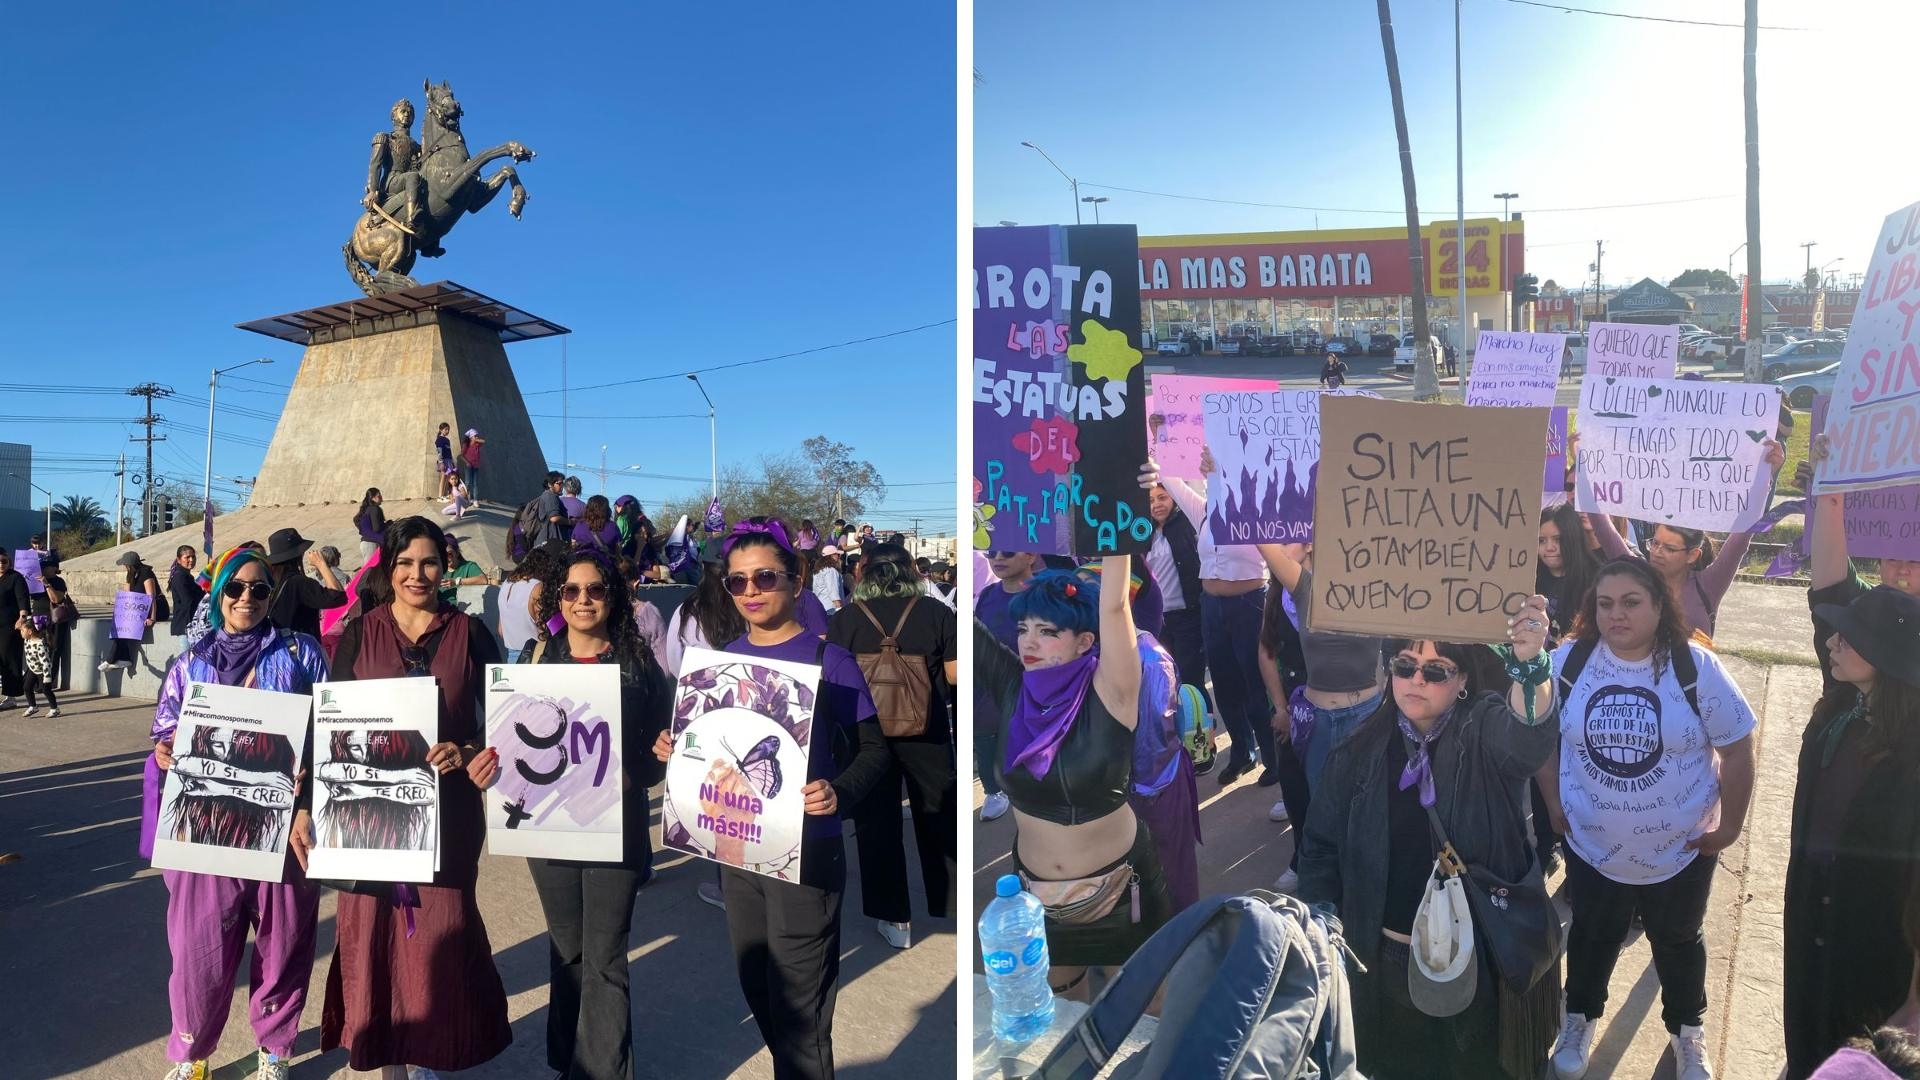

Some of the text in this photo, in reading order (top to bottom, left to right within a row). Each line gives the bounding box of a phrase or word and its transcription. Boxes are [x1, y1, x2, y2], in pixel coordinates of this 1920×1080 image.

[1138, 252, 1372, 290] LA MAS BARATA
[1439, 240, 1490, 274] 24
[973, 264, 1112, 318] ROTA
[1007, 322, 1072, 359] LAS
[1480, 333, 1524, 351] Marcho
[1594, 328, 1672, 360] QUIERO QUE
[973, 357, 1127, 421] ESTATUAS
[1205, 393, 1263, 414] SOMOS
[1272, 392, 1292, 414] EL
[1589, 382, 1767, 417] LUCHA AUNQUE LO
[1228, 416, 1260, 436] LAS
[1264, 416, 1292, 436] QUE
[1607, 426, 1739, 458] TENGAS TODO
[1822, 405, 1920, 475] MIED
[1030, 427, 1075, 461] DEL
[1347, 432, 1473, 484] SI ME
[1577, 449, 1606, 475] POR
[1613, 453, 1671, 480] TODAS
[1682, 461, 1711, 483] LAS
[1720, 463, 1753, 484] QUE
[987, 460, 1153, 552] PATRIARCADO
[1342, 485, 1527, 531] FALTA UNA
[1593, 480, 1750, 513] NO LO TIENEN
[1230, 522, 1250, 541] NO
[1257, 520, 1286, 540] NOS
[1338, 536, 1528, 573] YO TAMBIÉN LO
[1326, 577, 1531, 617] QUEMO TODO
[1589, 719, 1657, 736] GRITO DE LAS
[1600, 706, 1647, 719] SOMOS EL
[1590, 733, 1607, 746] QUE
[1610, 733, 1623, 745] NO
[201, 759, 216, 776] YO
[342, 764, 357, 779] YO
[1578, 748, 1589, 762] NO
[1584, 761, 1601, 781] NOS
[1600, 773, 1629, 793] VAMOS
[1630, 781, 1637, 793] A
[1637, 766, 1667, 792] CALLAR
[228, 786, 248, 797] TE
[372, 787, 391, 797] TE
[699, 782, 763, 816] Ni una
[1591, 793, 1621, 812] Paola
[1623, 800, 1657, 814] Andrea
